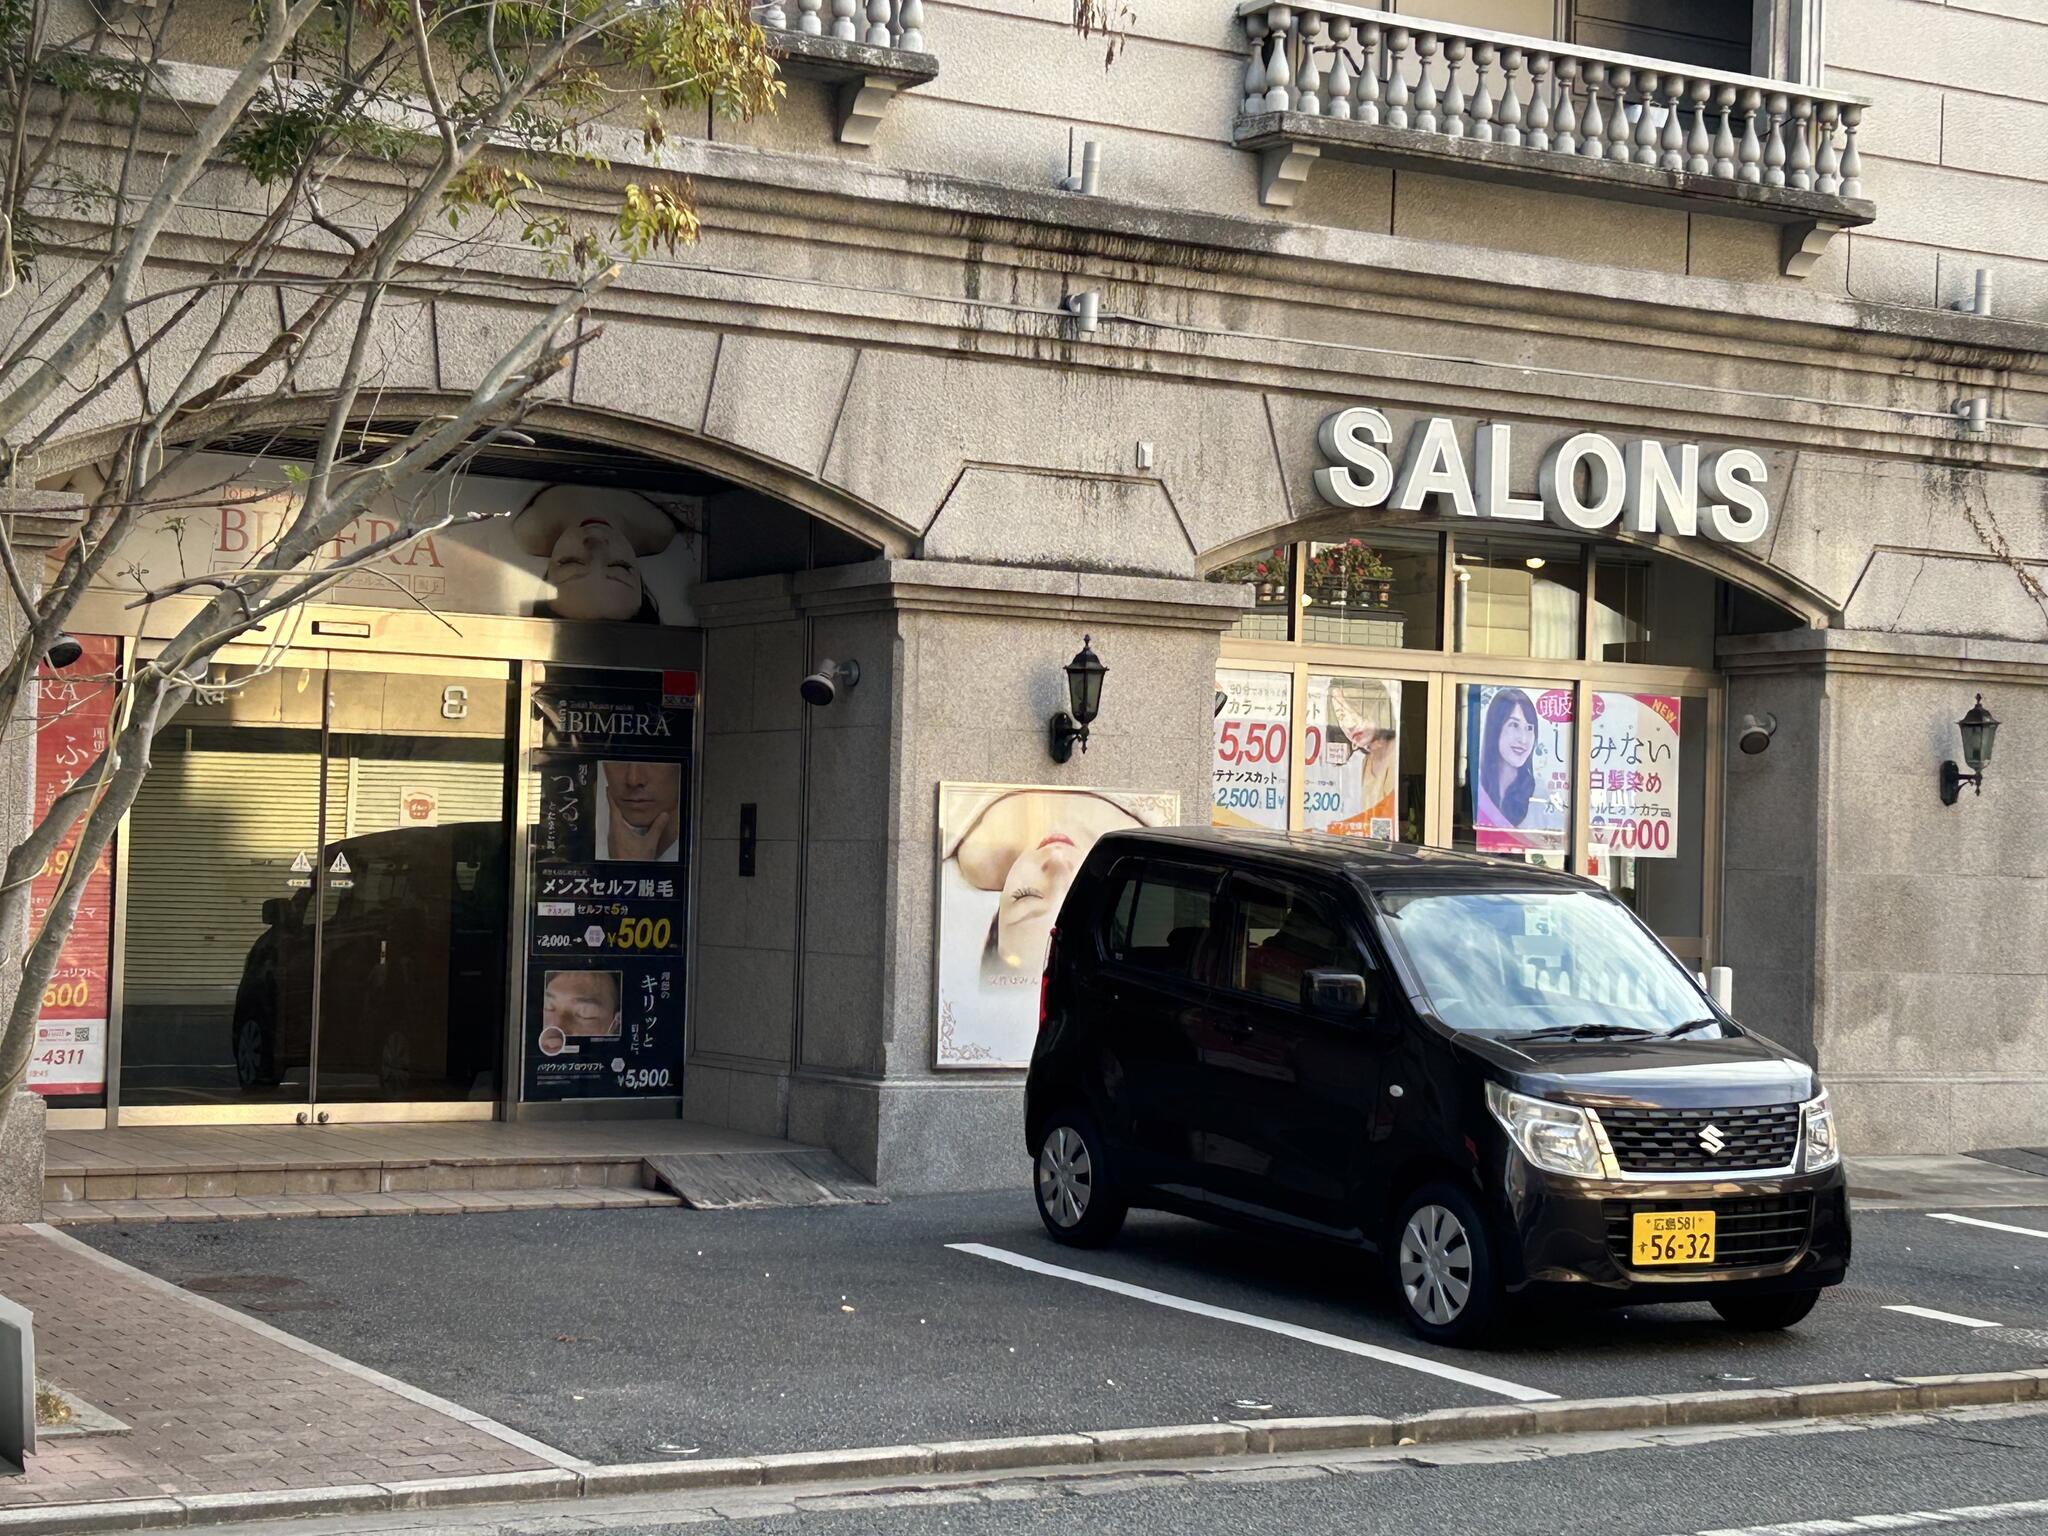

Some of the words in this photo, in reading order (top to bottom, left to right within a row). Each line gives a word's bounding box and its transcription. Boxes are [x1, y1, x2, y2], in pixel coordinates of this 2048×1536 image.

[1314, 407, 1770, 543] SALONS
[568, 710, 671, 736] BIMERA
[1651, 699, 1677, 725] NEW
[1590, 769, 1662, 793] 白髪染め
[541, 878, 674, 898] メンズセルフ脱毛
[576, 902, 629, 916] セルフで5分
[607, 917, 671, 949] ¥500
[640, 974, 658, 1049] キリッと
[616, 1068, 670, 1090] ¥5,900
[1650, 1232, 1711, 1261] 56-32
